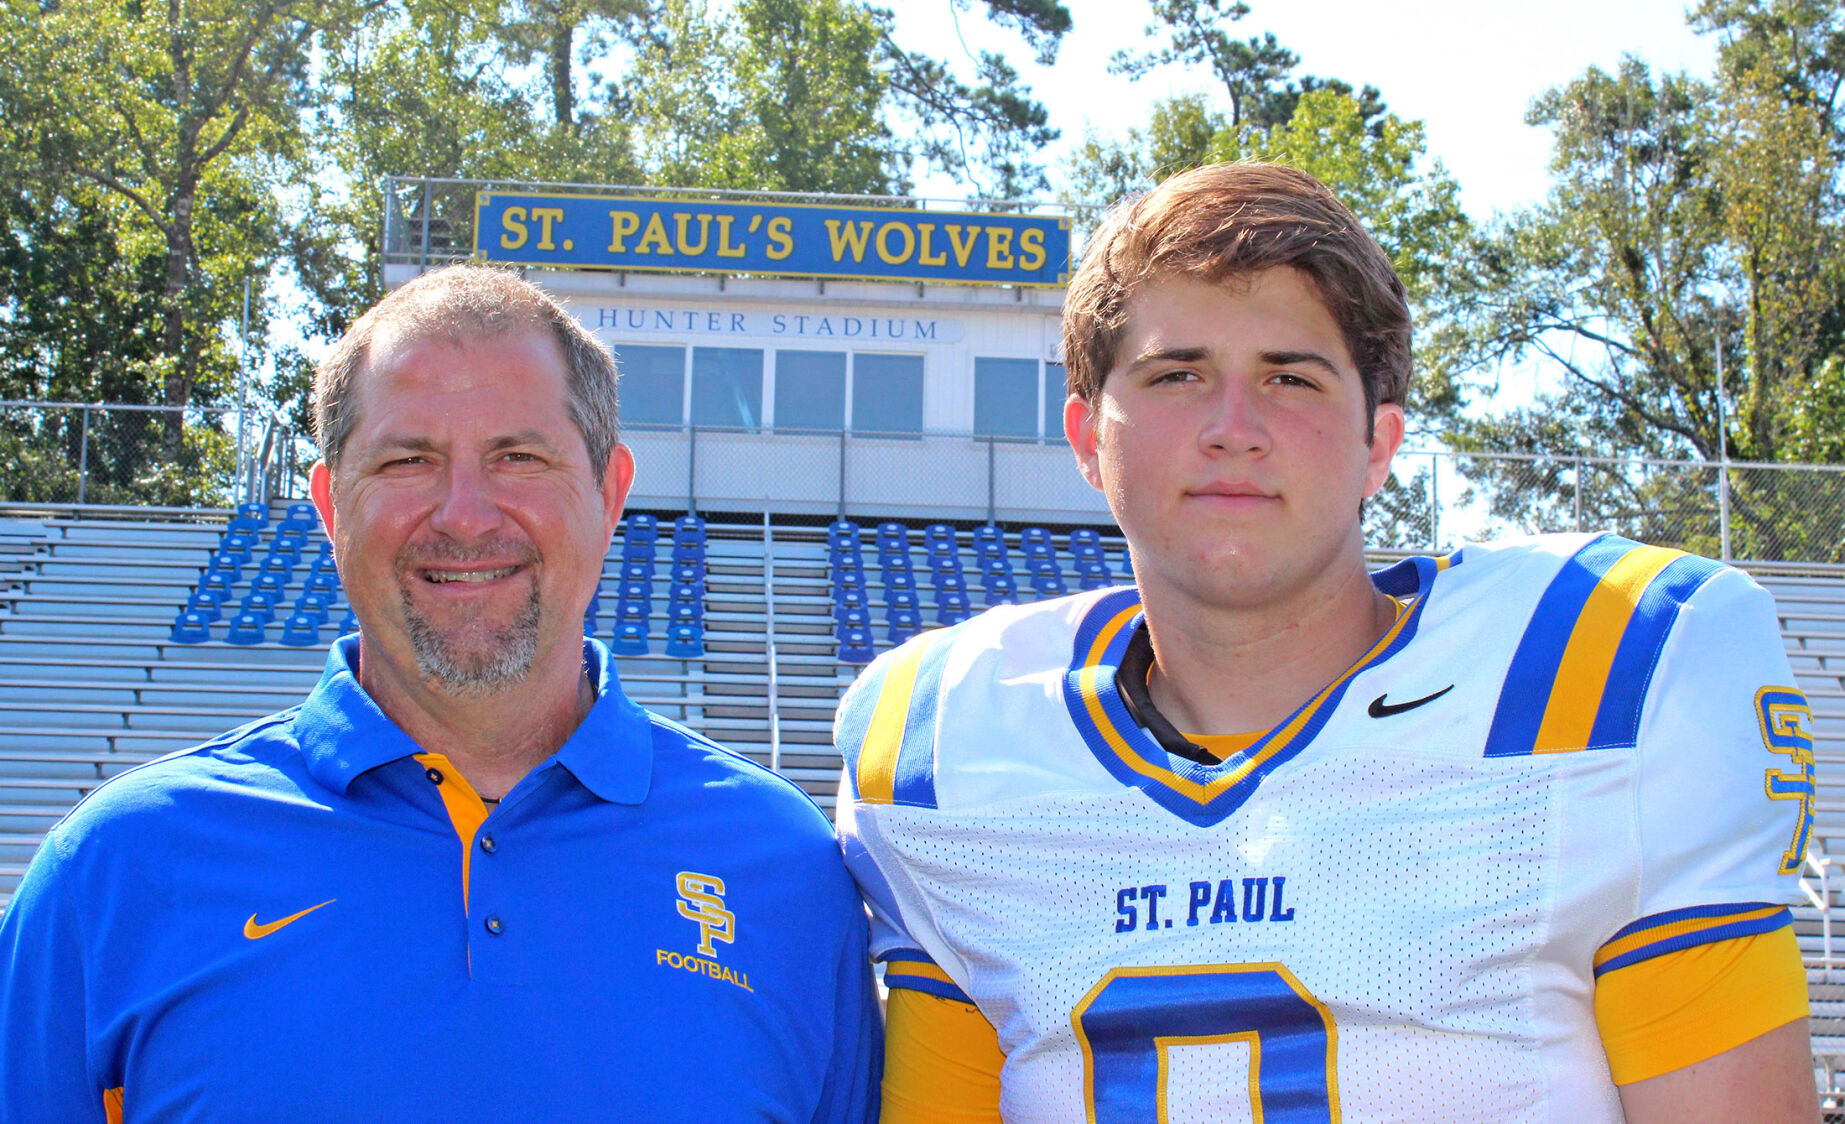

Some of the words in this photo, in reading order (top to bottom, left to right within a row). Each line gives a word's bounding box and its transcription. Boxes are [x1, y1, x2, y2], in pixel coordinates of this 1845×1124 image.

[500, 206, 574, 251] ST.
[608, 210, 793, 260] PAUL'S
[824, 219, 1047, 271] WOLVES
[599, 308, 747, 332] HUNTER
[772, 314, 939, 339] STADIUM
[1115, 884, 1173, 933] ST.
[1186, 876, 1295, 927] PAUL
[656, 949, 754, 993] FOOTBALL
